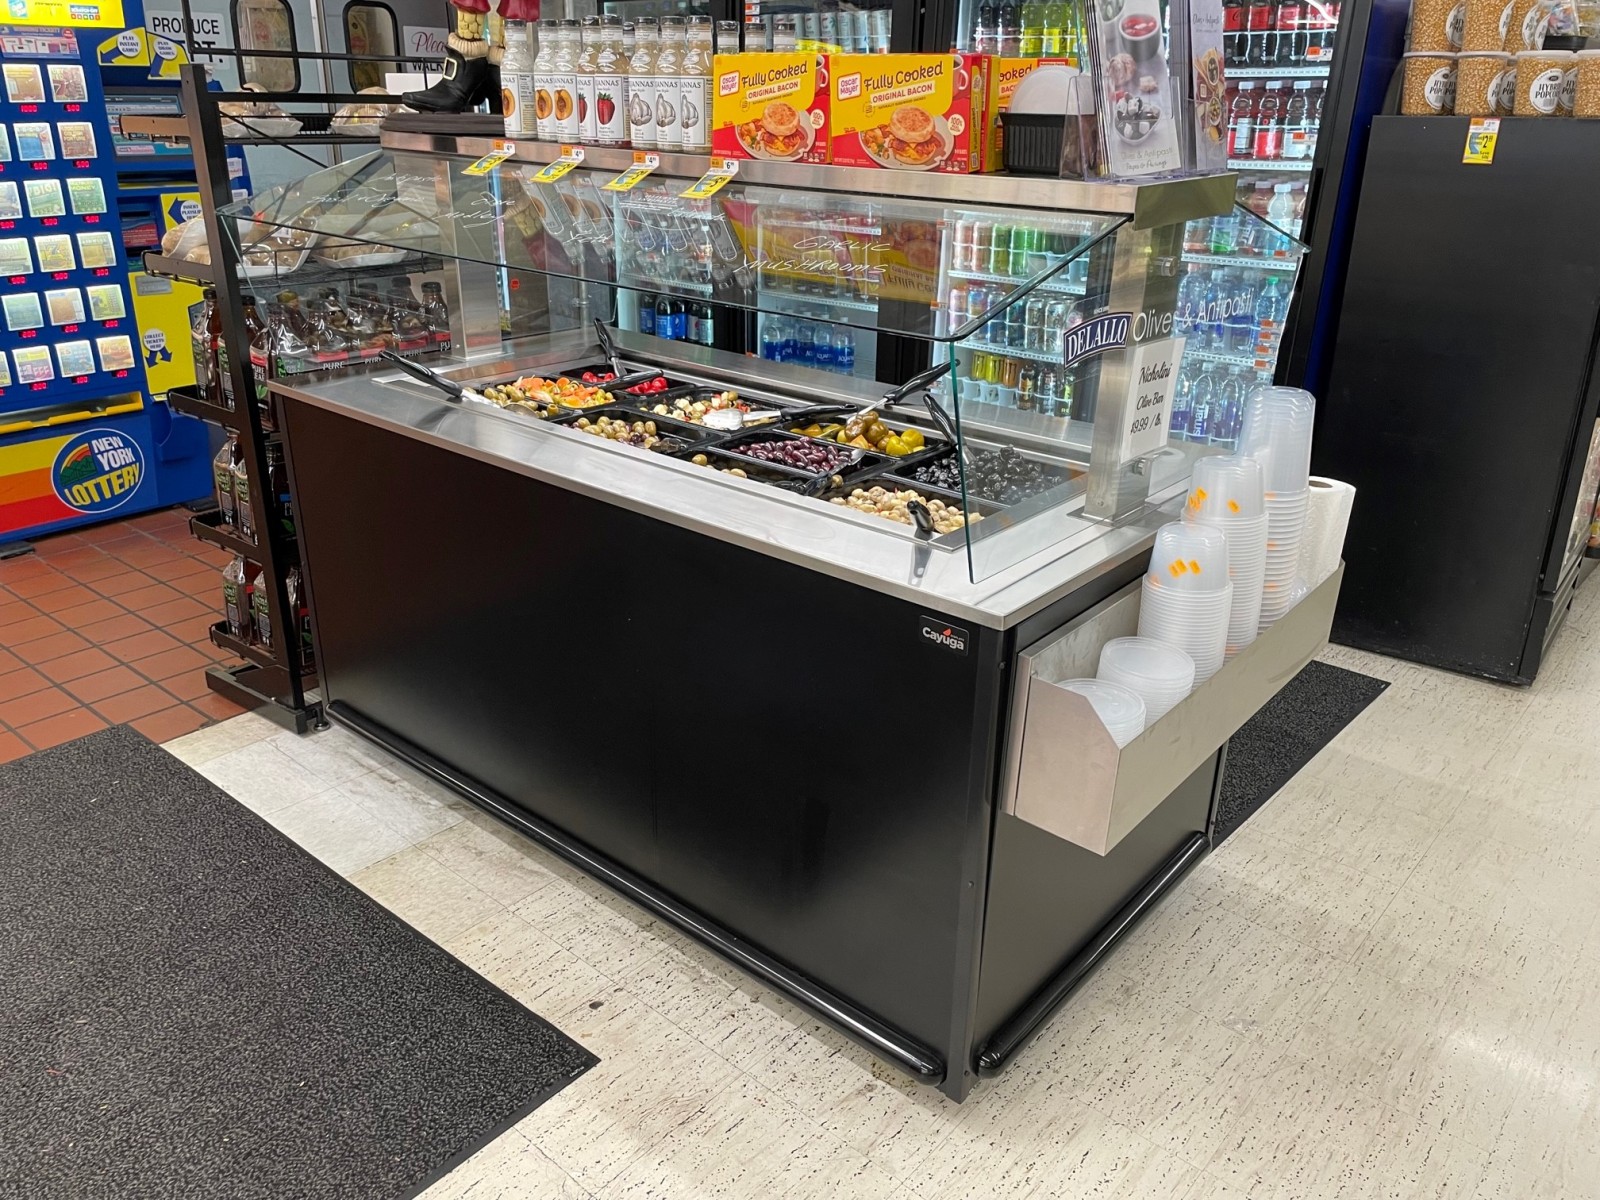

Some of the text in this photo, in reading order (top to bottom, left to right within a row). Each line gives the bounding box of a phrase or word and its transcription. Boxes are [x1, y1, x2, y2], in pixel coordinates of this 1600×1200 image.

[153, 17, 220, 35] PROUCE
[411, 31, 446, 54] Plea
[722, 75, 737, 85] Oscar
[741, 61, 807, 88] Fully Cooked
[840, 77, 858, 87] Oscar
[864, 60, 943, 92] Fully Cooked
[722, 82, 737, 92] Mayer
[748, 87, 776, 99] ORIGINAL
[777, 81, 799, 92] BACON
[840, 84, 858, 96] Mayer
[872, 83, 933, 103] ORIGINAL BACON
[793, 236, 891, 251] GARLIC
[734, 256, 889, 273] MUSHROOMS
[1182, 303, 1193, 328] &
[1196, 288, 1255, 324] Antipasti
[1067, 318, 1128, 362] DELALLO
[323, 362, 345, 370] PURE
[1138, 361, 1173, 385] Nicholini
[1137, 391, 1164, 411] Olive Bar
[91, 436, 124, 453] NEW
[97, 447, 136, 471] YORK
[64, 462, 140, 507] LOTTERY
[922, 626, 964, 650] Cayuga
